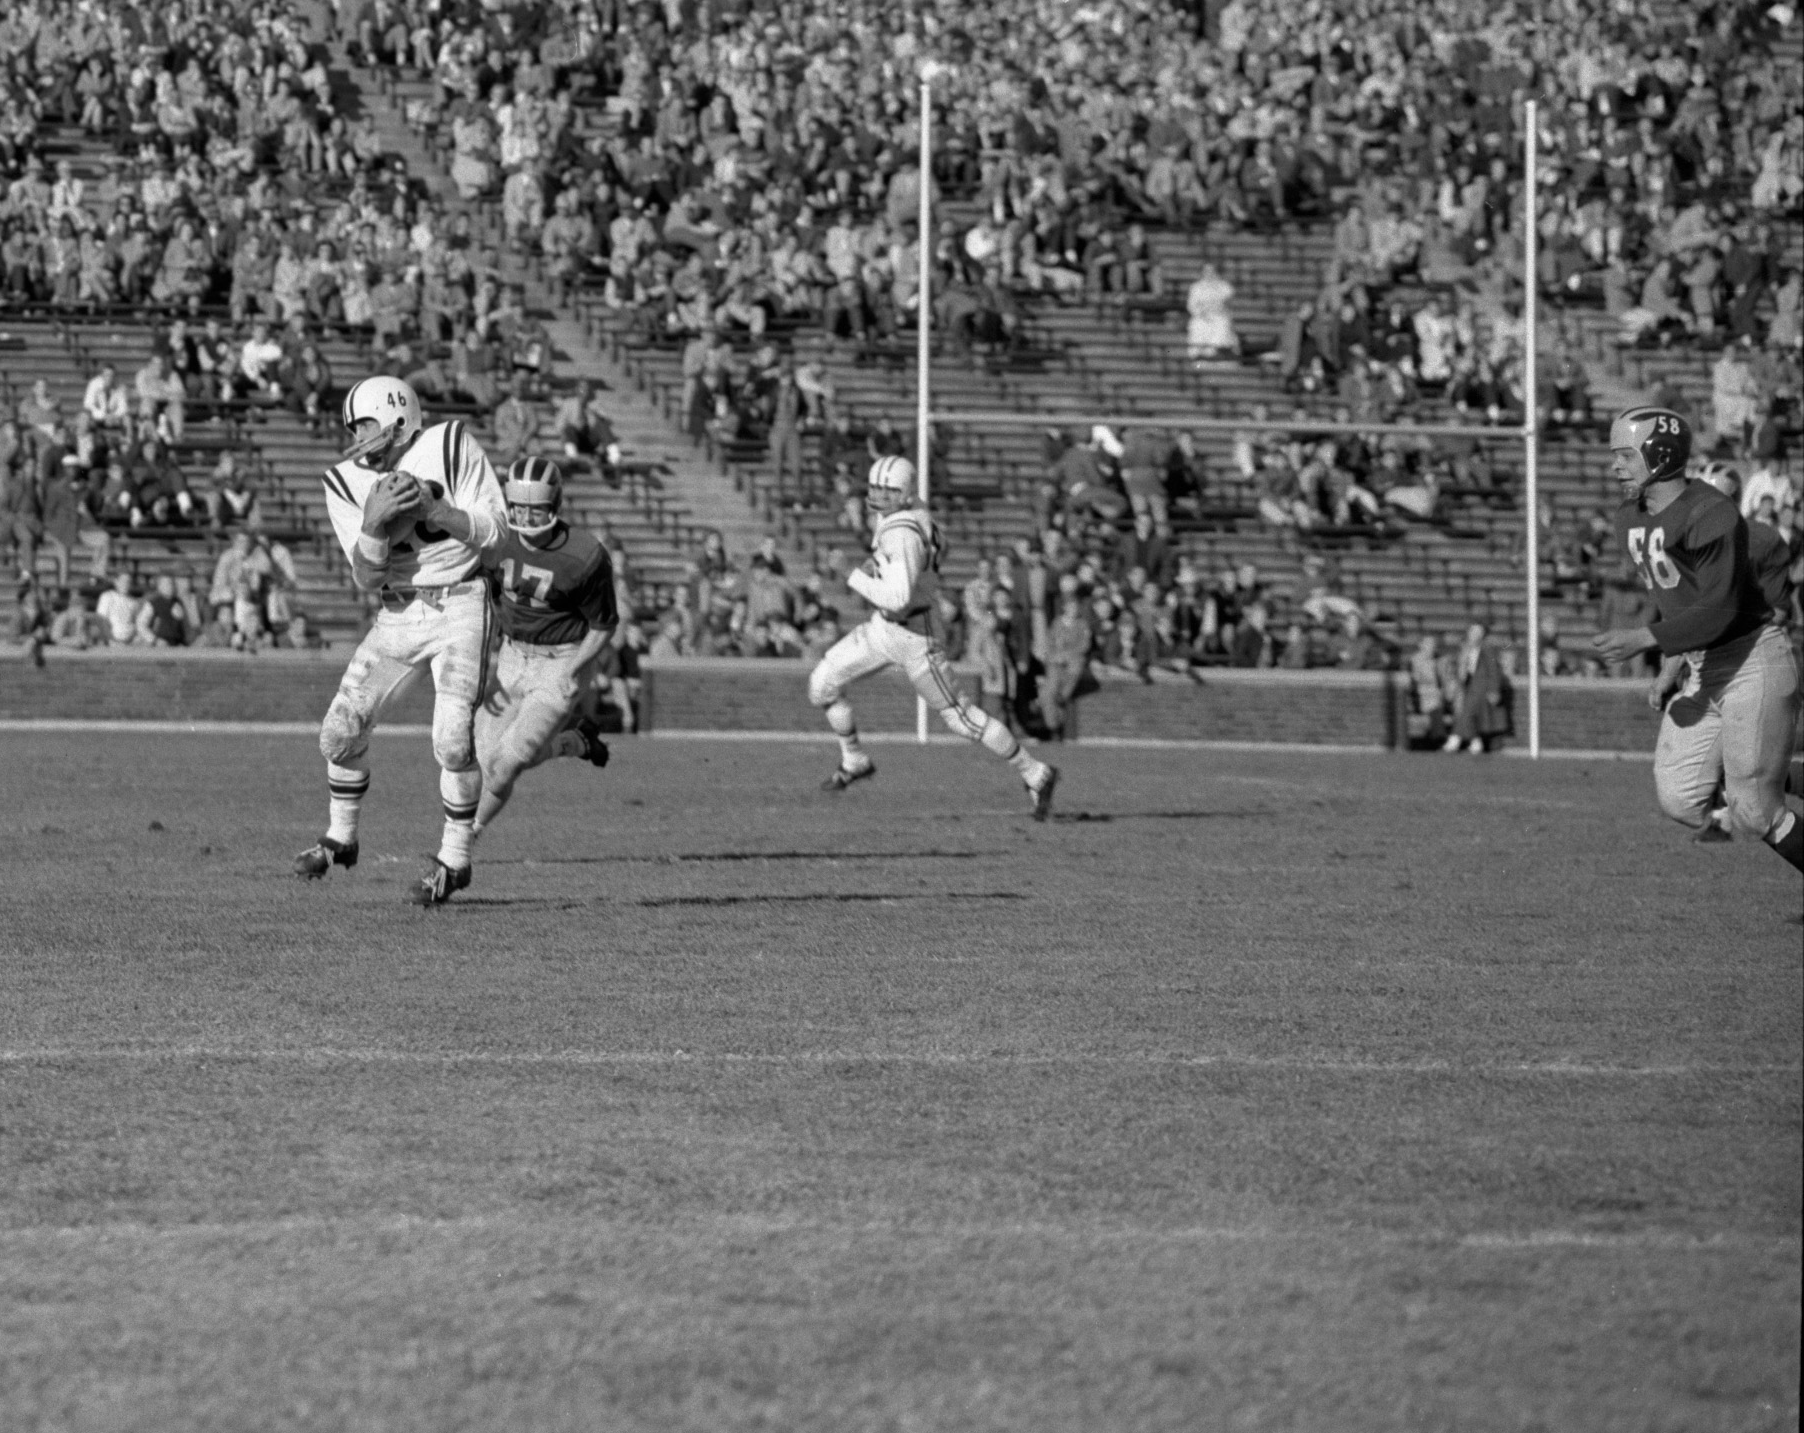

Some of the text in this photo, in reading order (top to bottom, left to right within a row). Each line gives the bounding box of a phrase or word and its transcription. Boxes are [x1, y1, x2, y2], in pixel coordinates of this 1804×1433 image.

[386, 391, 408, 408] 46
[1657, 416, 1681, 435] 58
[1627, 526, 1682, 590] 58
[499, 558, 554, 608] 17
